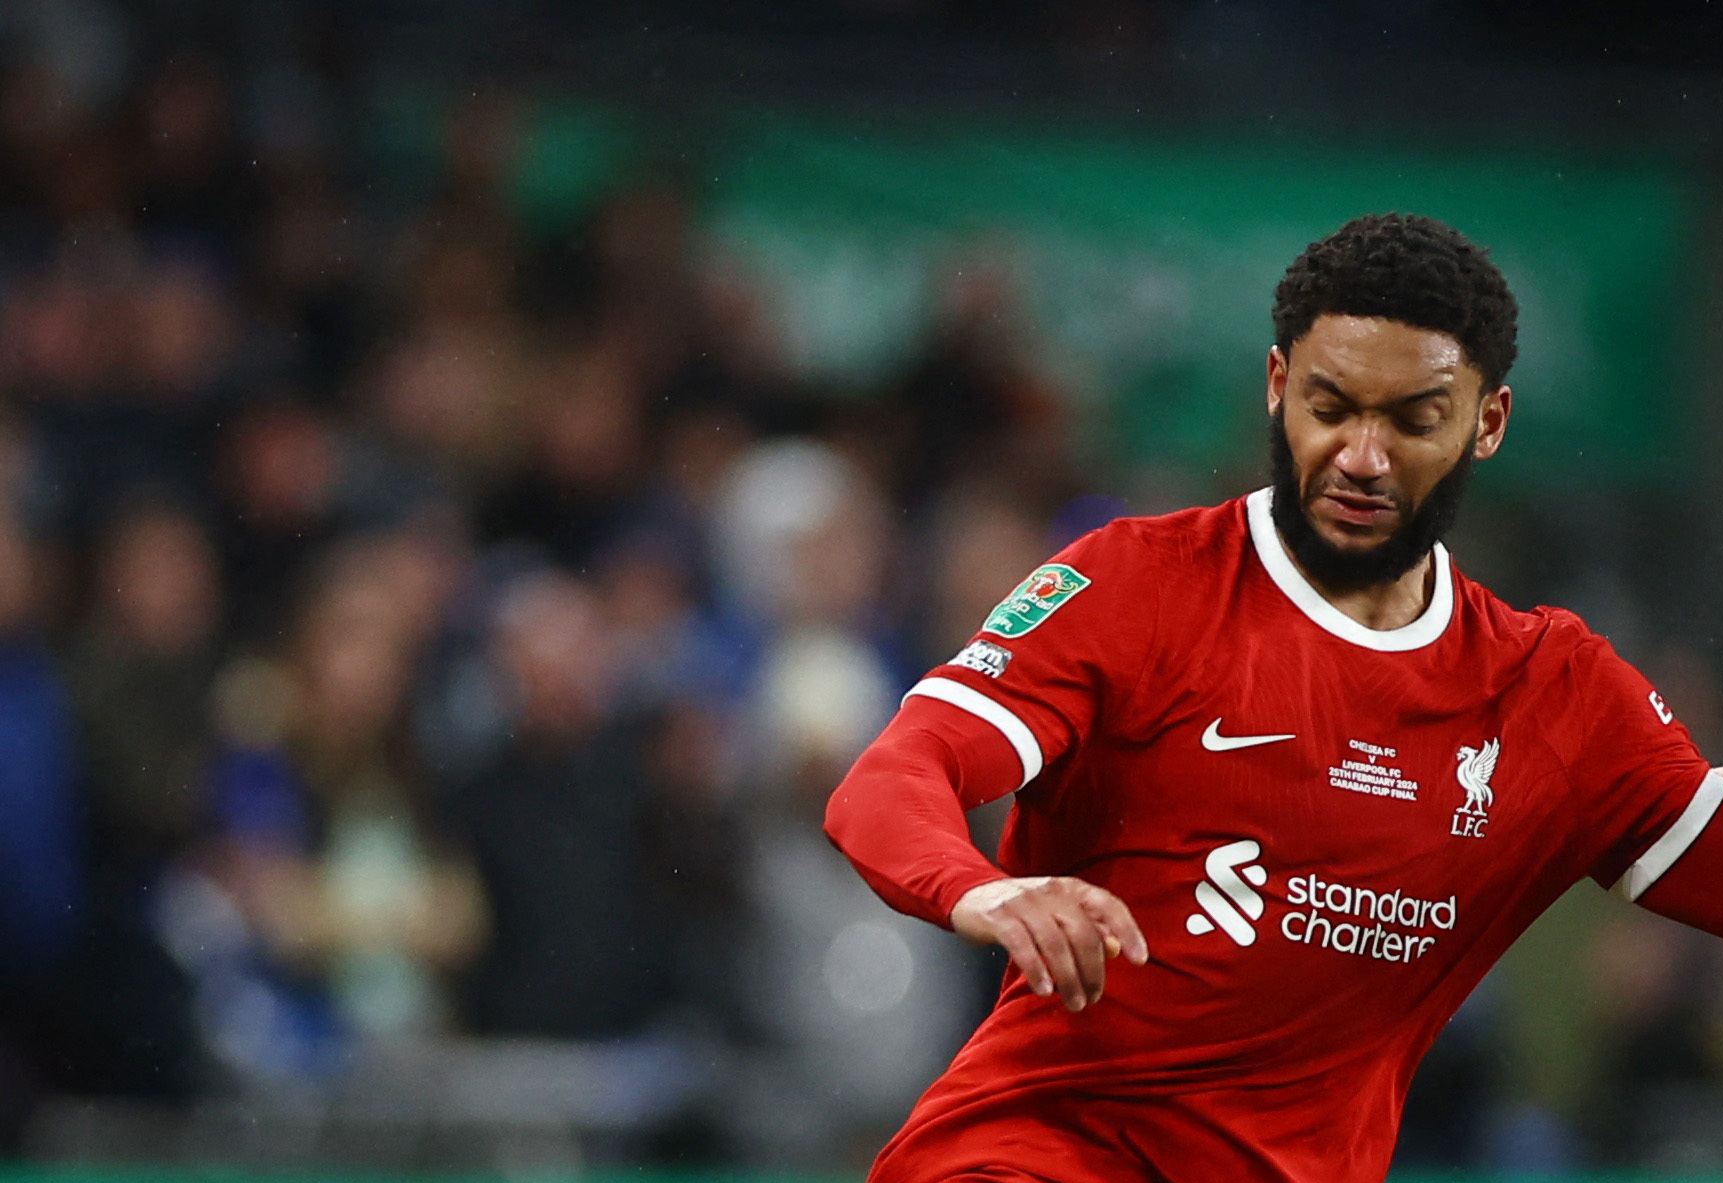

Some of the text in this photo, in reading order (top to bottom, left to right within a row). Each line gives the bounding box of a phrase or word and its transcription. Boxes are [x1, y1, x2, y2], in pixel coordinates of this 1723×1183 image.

[1349, 739, 1397, 757] CHELSEA FC
[1328, 767, 1418, 790] 25TH FEBRUARY 2024
[1342, 759, 1401, 778] LIVERPOOL FC
[1330, 778, 1417, 801] CARABAO CUP FINAL
[1287, 873, 1456, 930] standard
